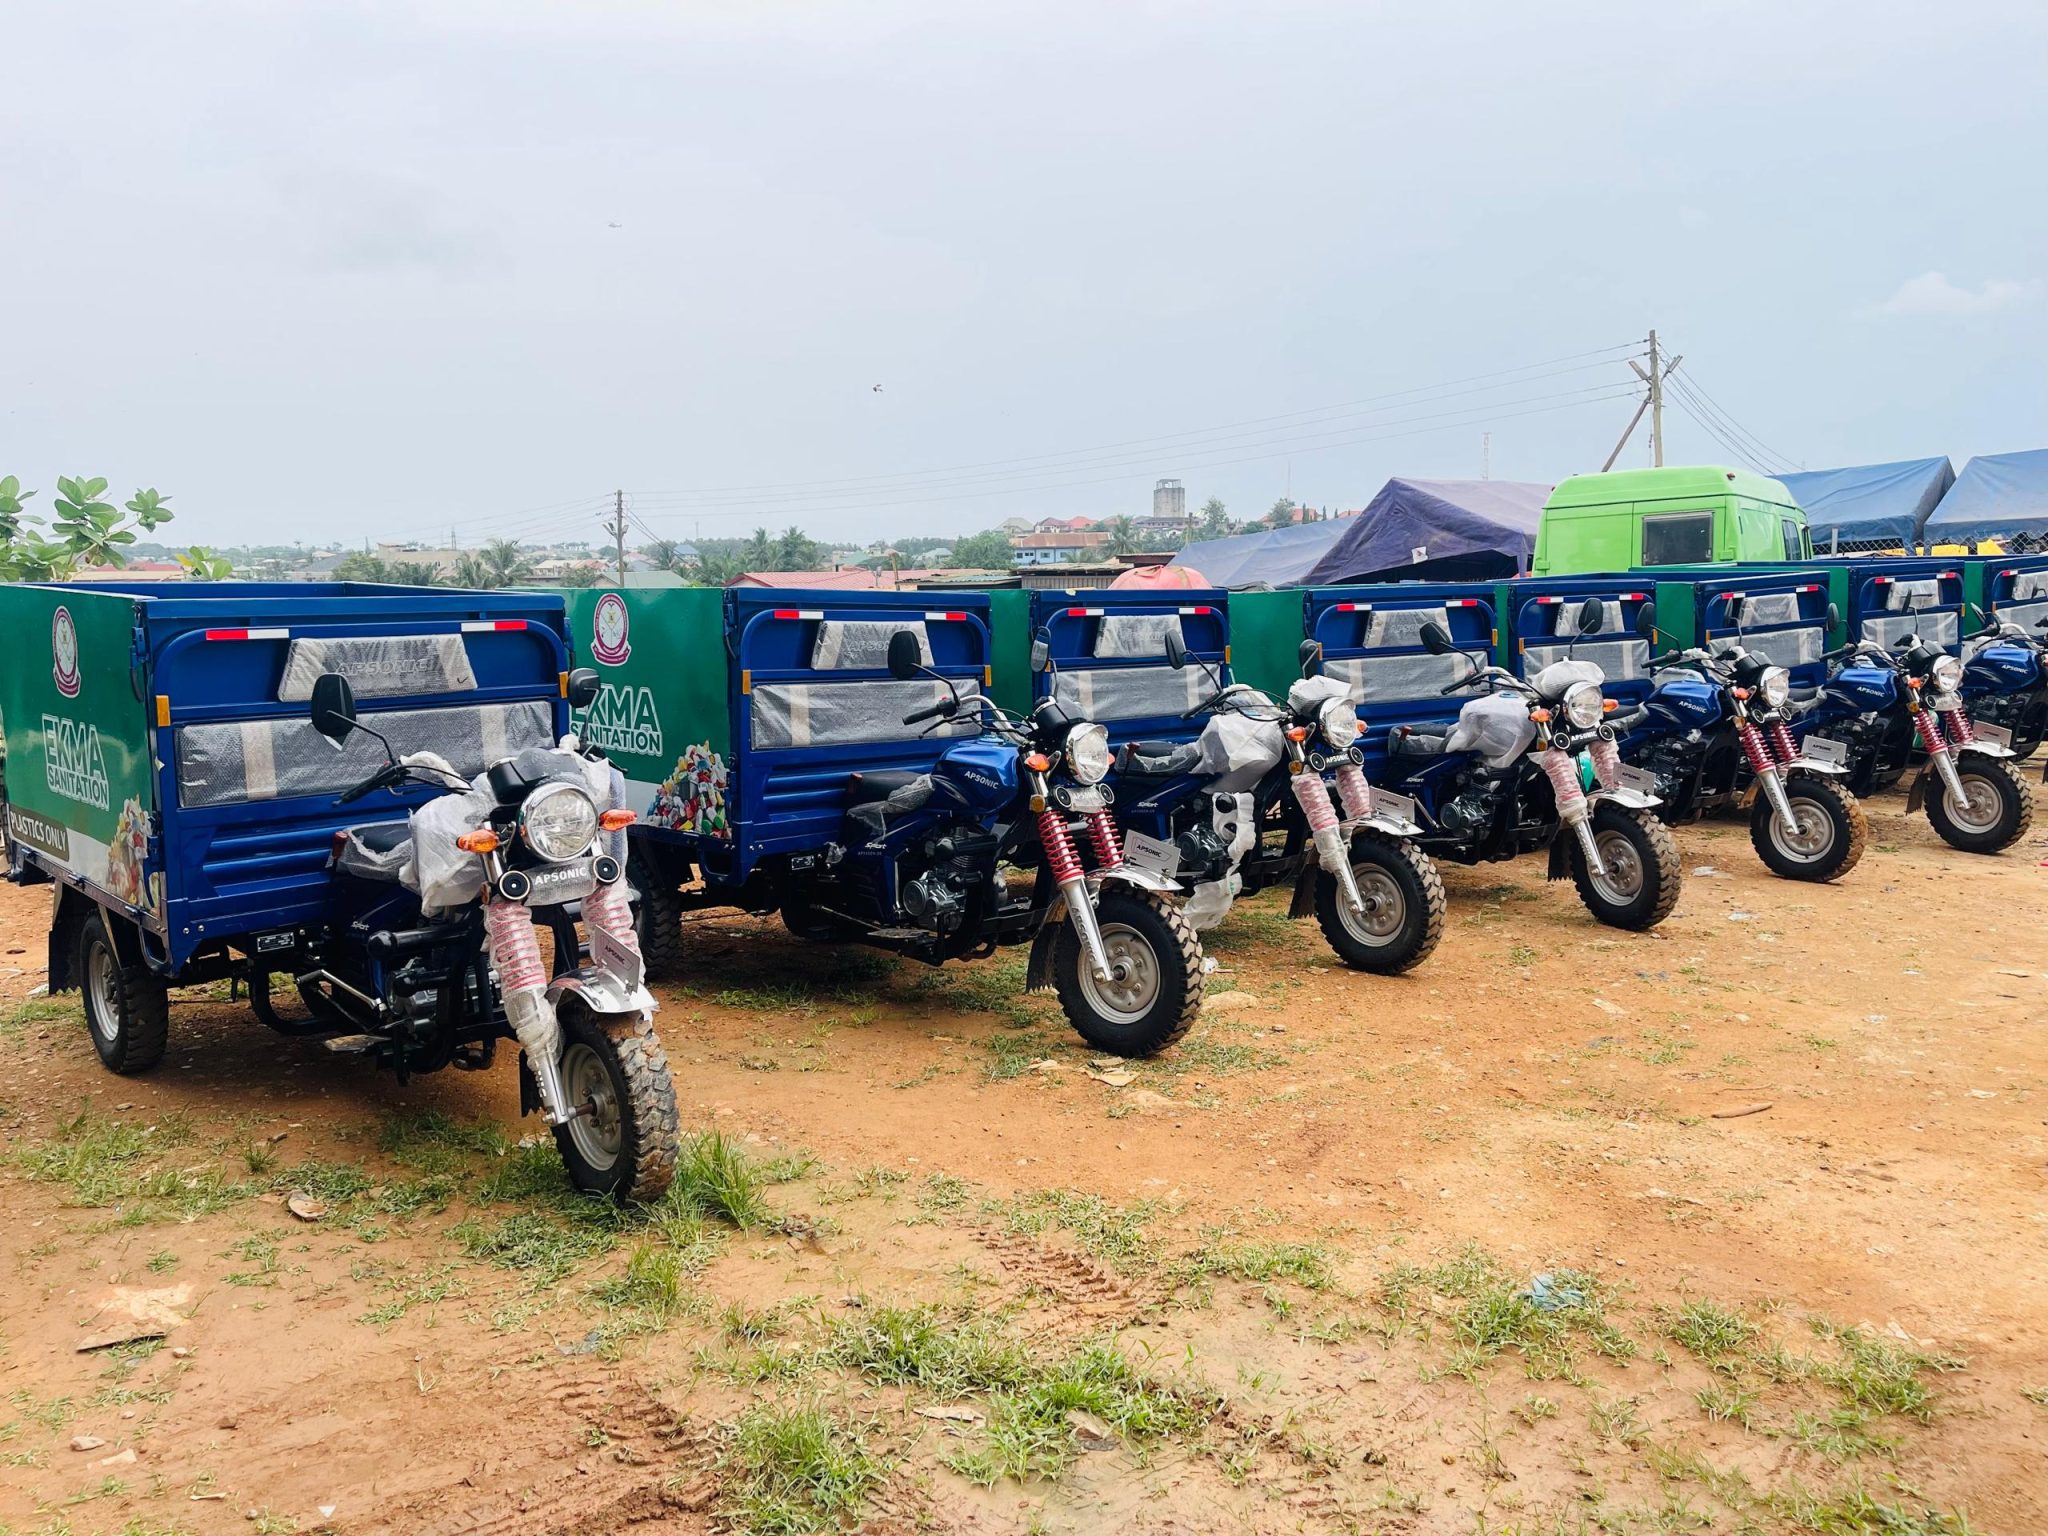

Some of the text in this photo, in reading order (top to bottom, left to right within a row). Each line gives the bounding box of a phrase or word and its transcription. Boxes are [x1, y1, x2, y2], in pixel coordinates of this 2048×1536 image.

[335, 658, 429, 677] APSONIC
[2001, 663, 2029, 674] APSONIC
[1857, 686, 1885, 698] APSONIC
[1678, 700, 1708, 714] APSONIC
[42, 713, 106, 781] EKMA
[569, 721, 662, 756] SNITATION
[47, 764, 109, 811] SANITATION
[964, 769, 999, 790] APSONIC
[10, 810, 66, 852] PLASTICS ONLY
[1136, 844, 1162, 858] APSONIC
[533, 866, 587, 886] APSONIC
